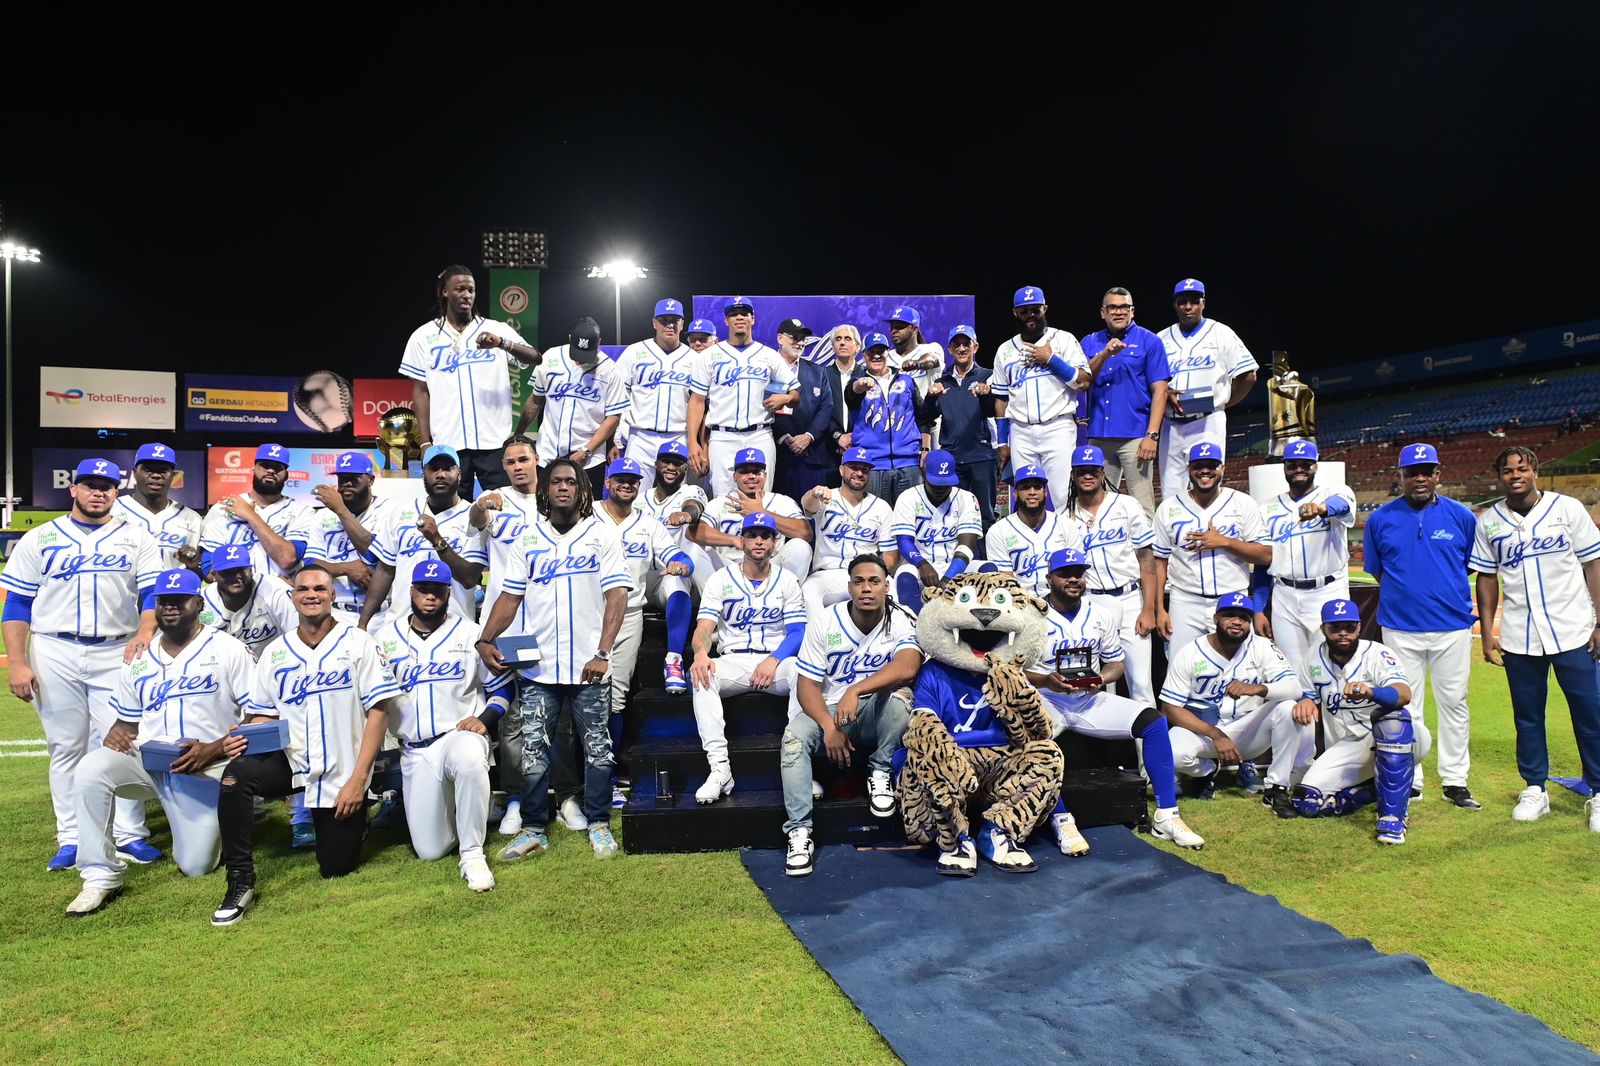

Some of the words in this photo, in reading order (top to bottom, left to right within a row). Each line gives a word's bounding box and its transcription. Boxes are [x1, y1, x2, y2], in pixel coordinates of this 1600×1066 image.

[1184, 278, 1194, 289] L
[508, 293, 520, 306] P
[1024, 289, 1033, 300] L
[666, 300, 675, 311] L
[893, 308, 902, 318] L
[431, 344, 496, 372] Tigres
[713, 361, 769, 387] Tigres
[545, 372, 601, 401] Tigres
[87, 393, 166, 405] TotalEnergies
[209, 398, 243, 406] GERDAU
[199, 413, 277, 424] #FanáticosDeAcero
[152, 445, 166, 457] L
[269, 446, 281, 457] L
[668, 442, 679, 453] L
[857, 449, 866, 459] L
[1200, 444, 1210, 456] L
[1294, 442, 1305, 454] L
[1415, 446, 1426, 459] L
[224, 451, 241, 467] G
[340, 455, 352, 467] L
[746, 450, 755, 461] L
[1083, 449, 1093, 460] L
[93, 461, 108, 474] L
[623, 459, 633, 469] L
[939, 463, 948, 474] L
[1026, 465, 1037, 475] L
[754, 512, 765, 524] L
[821, 511, 878, 543] Tigres
[915, 517, 957, 544] Tigre
[324, 530, 356, 561] Tig
[1081, 526, 1127, 555] gres
[227, 546, 239, 559] L
[1066, 550, 1077, 562] L
[1490, 533, 1571, 568] Tigres
[41, 544, 132, 581] Tigres
[526, 548, 600, 585] Tigres
[1009, 546, 1050, 577] Tigr
[425, 564, 438, 577] L
[166, 573, 180, 588] L
[1232, 595, 1243, 606] L
[1335, 602, 1346, 615] L
[827, 649, 893, 683] Tigres
[389, 654, 466, 693] Tigres
[134, 671, 219, 711] Tigres
[274, 663, 353, 706] Tigres
